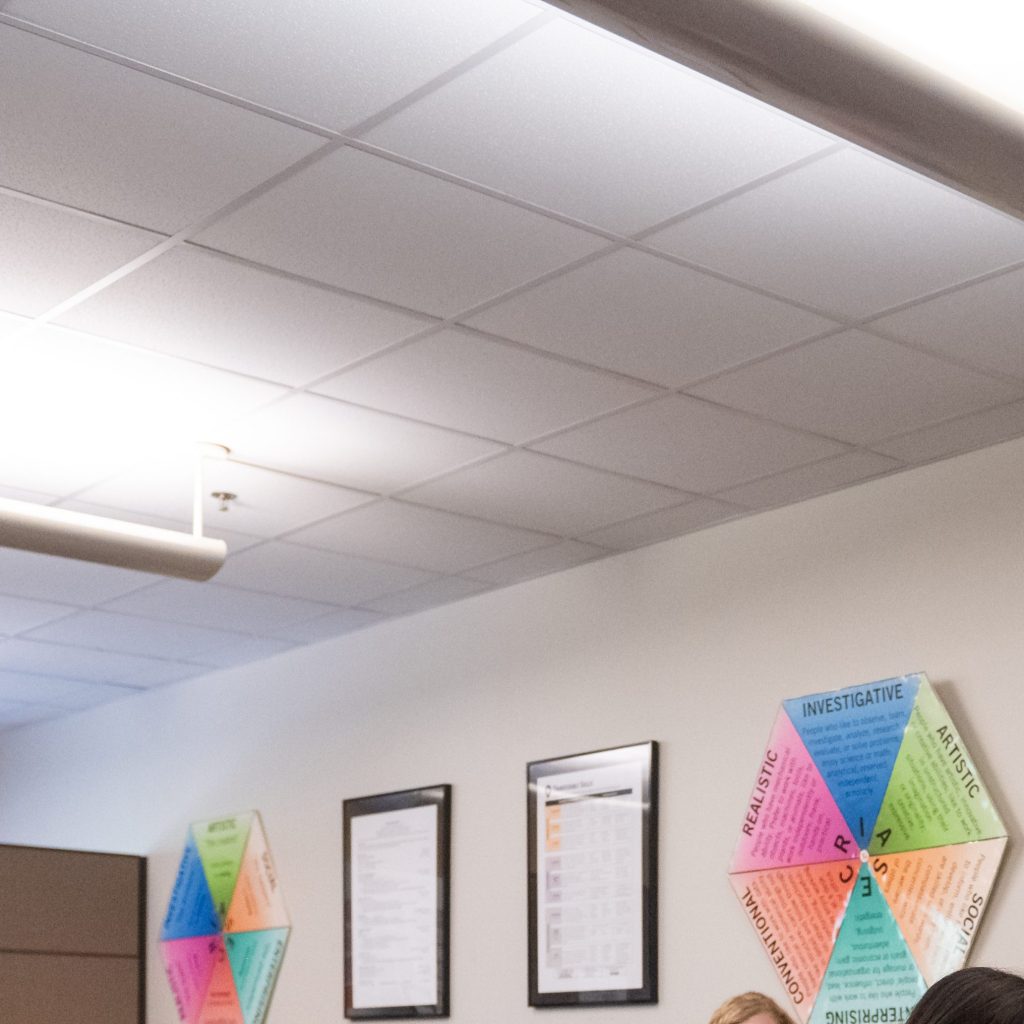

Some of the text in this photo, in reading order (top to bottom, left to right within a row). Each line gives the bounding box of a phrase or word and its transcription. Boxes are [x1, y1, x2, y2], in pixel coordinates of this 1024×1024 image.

[802, 683, 903, 718] INVESTIGATIVE
[936, 724, 980, 799] ARTISTIC
[742, 750, 777, 836] REALISTIC
[858, 815, 864, 837] I
[876, 826, 893, 848] A
[833, 834, 851, 852] R
[838, 864, 854, 884] C
[872, 858, 888, 876] S
[859, 875, 872, 897] E
[952, 892, 984, 955] SOCIAL
[742, 885, 804, 1005] CONVENTIONAL
